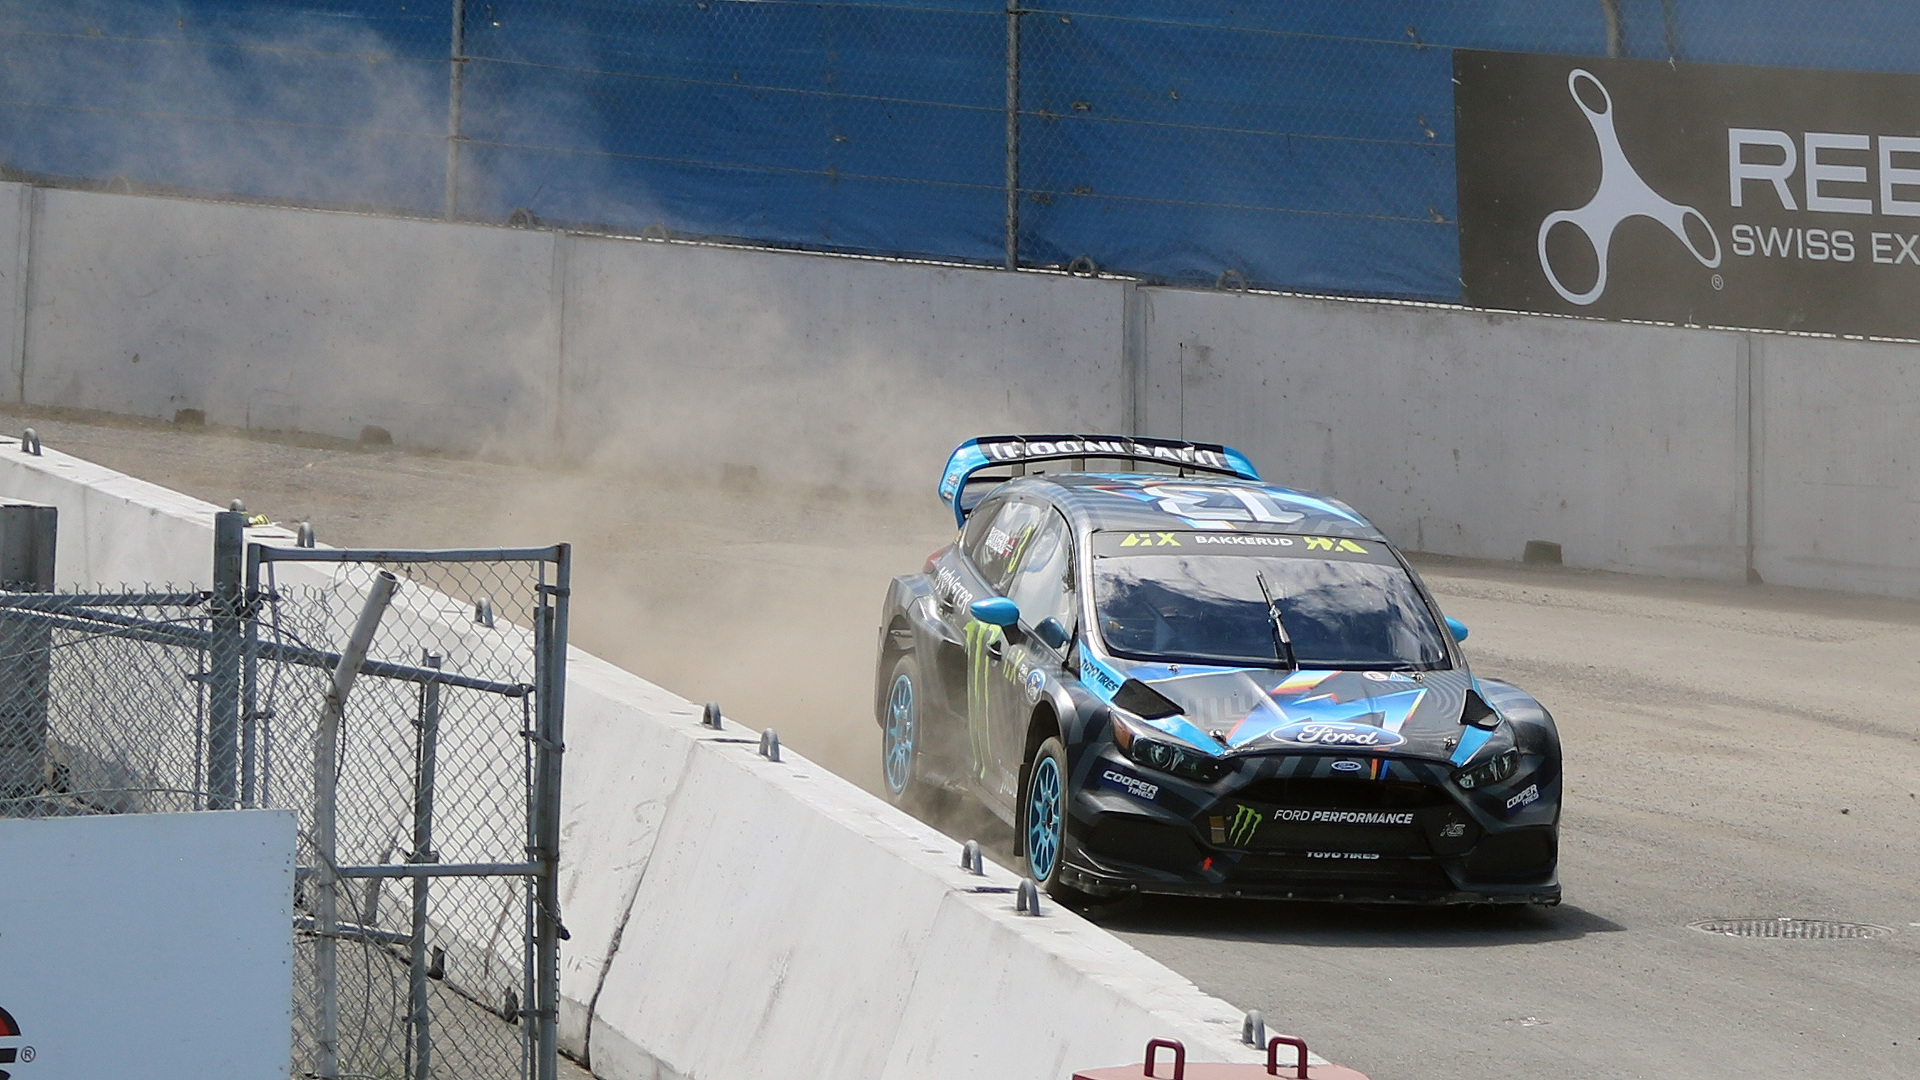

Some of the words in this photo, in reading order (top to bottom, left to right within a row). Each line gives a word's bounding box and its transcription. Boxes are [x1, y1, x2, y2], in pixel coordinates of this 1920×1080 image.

[1728, 128, 1920, 216] REE
[1731, 224, 1855, 262] SWISS
[1871, 231, 1920, 266] EX
[1195, 535, 1293, 547] BAKKERUD
[1081, 659, 1101, 681] TOYO
[1094, 669, 1120, 692] TIRES
[1297, 724, 1379, 743] Ford
[1102, 770, 1159, 795] COOPER
[1127, 785, 1156, 800] TIRES
[1507, 784, 1538, 809] COOPER
[1274, 809, 1310, 821] FORD
[1311, 811, 1414, 824] PERFORMANCE
[1343, 852, 1380, 860] TIRES
